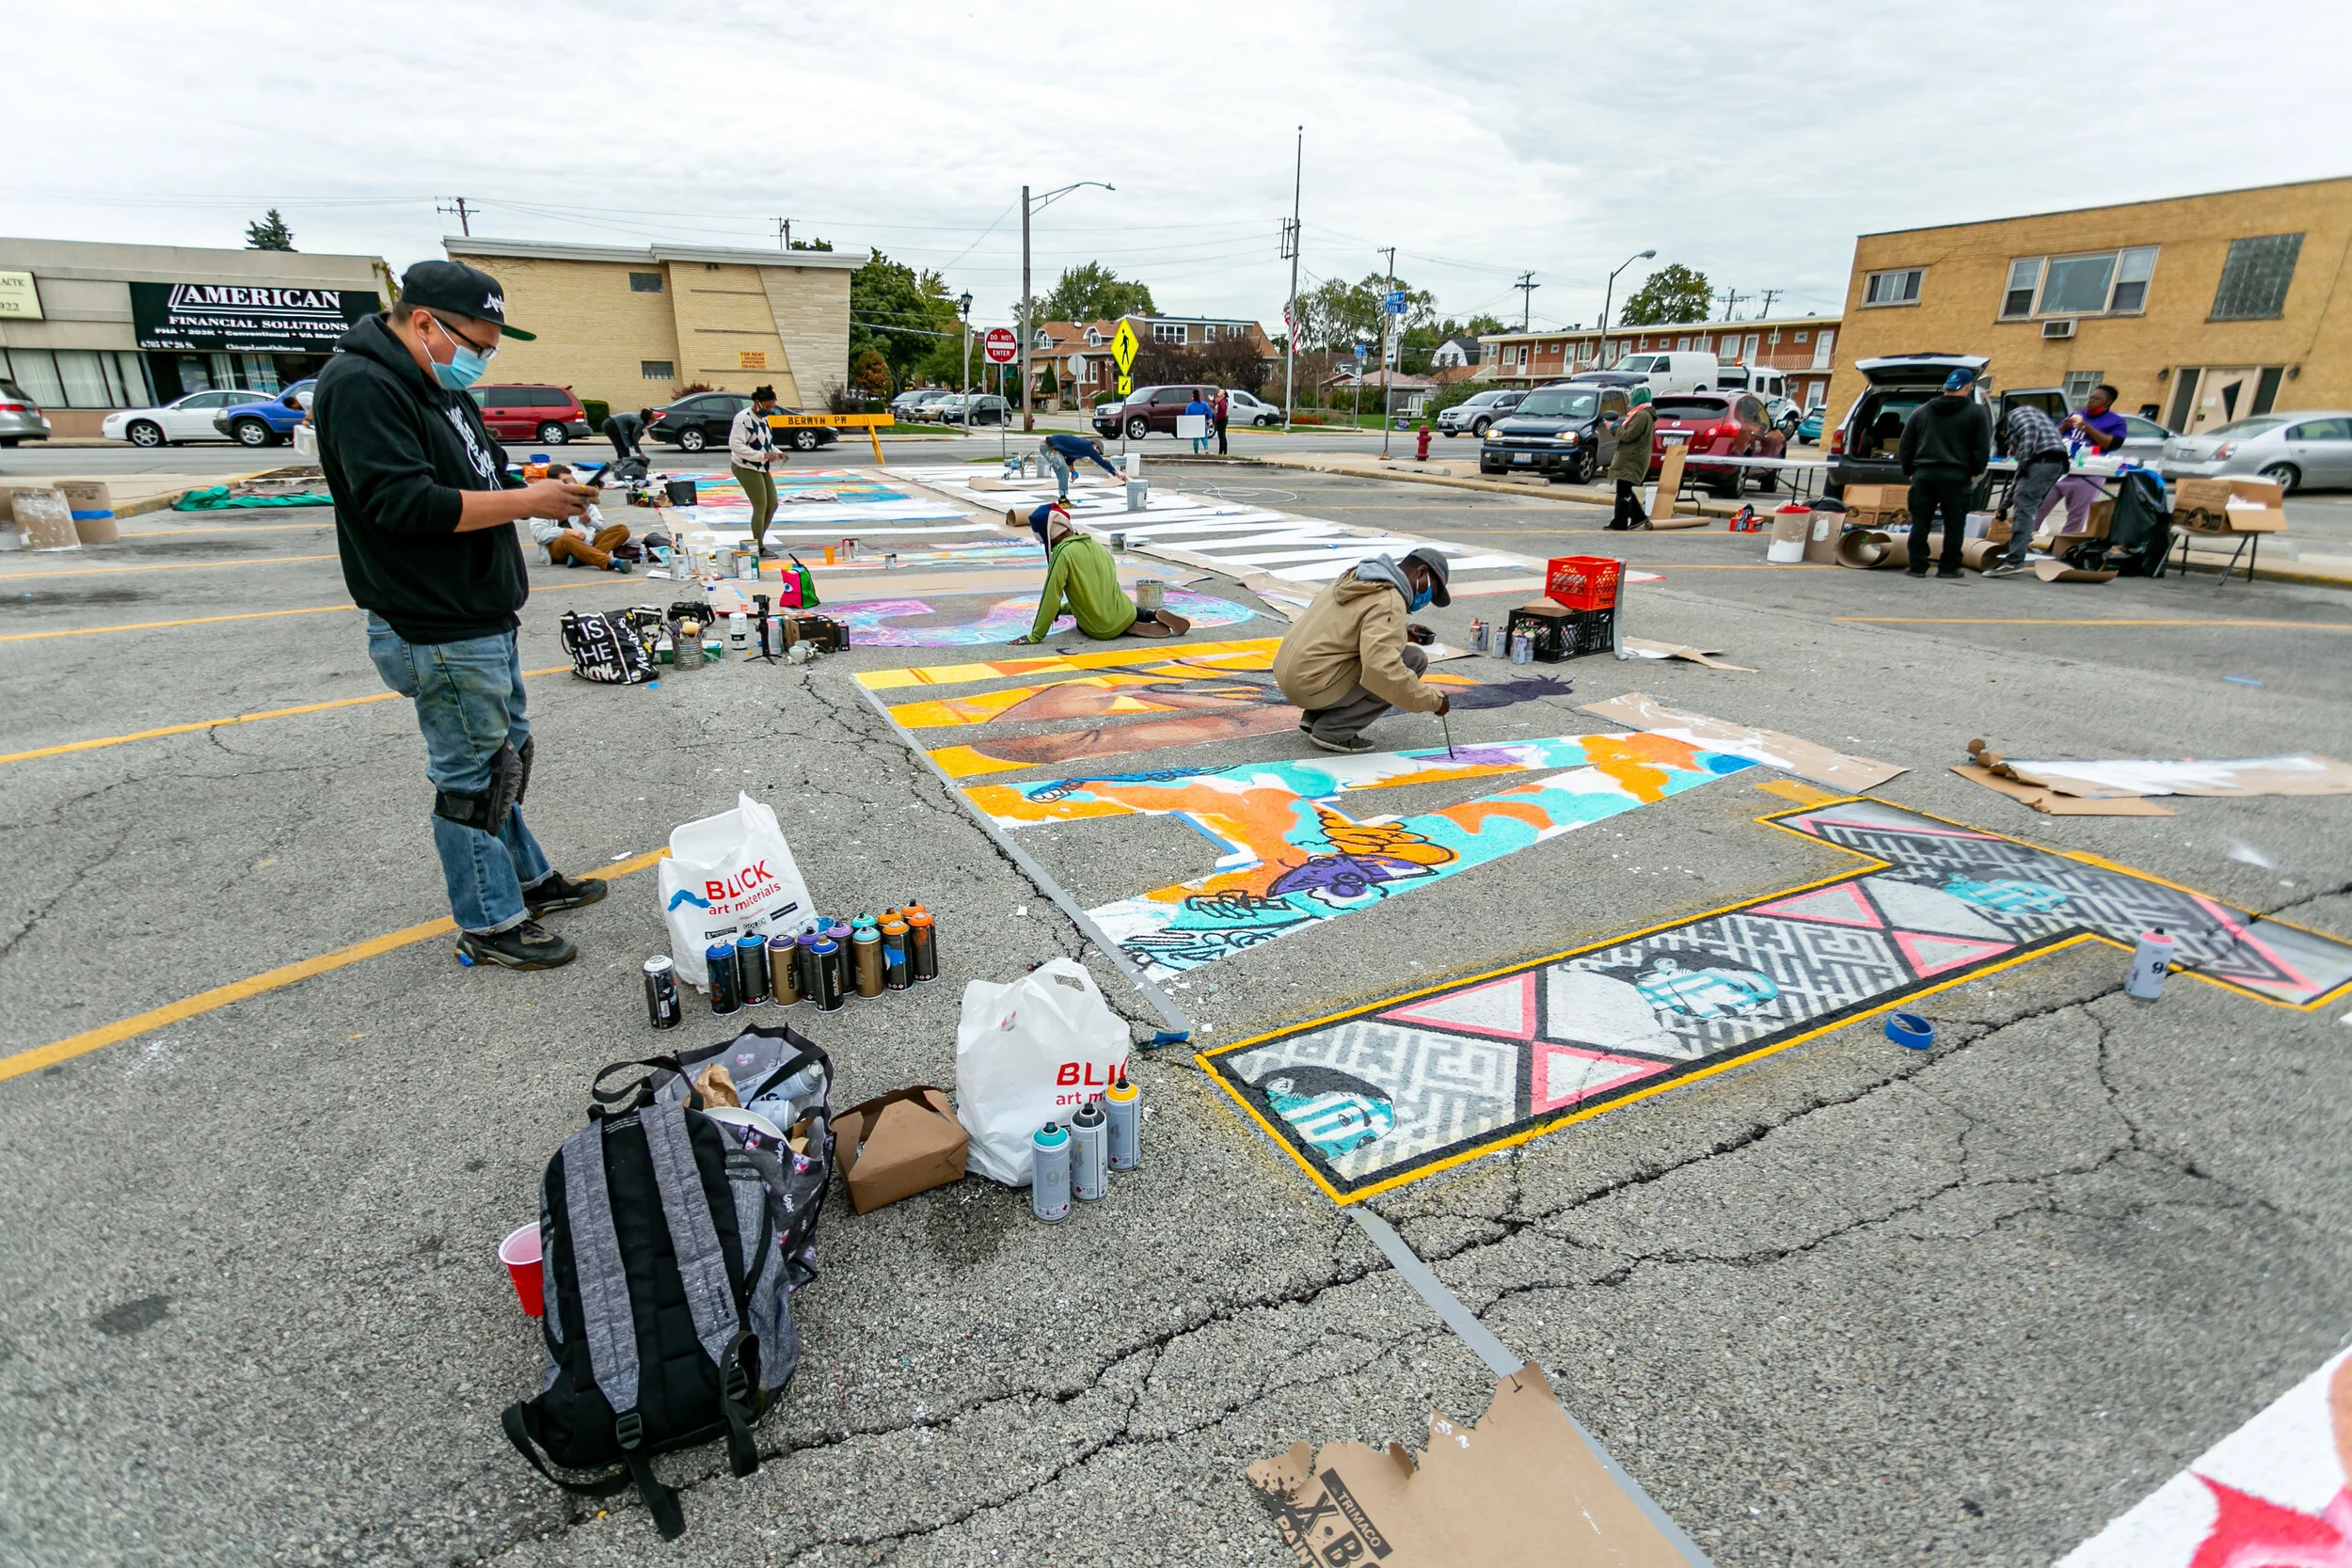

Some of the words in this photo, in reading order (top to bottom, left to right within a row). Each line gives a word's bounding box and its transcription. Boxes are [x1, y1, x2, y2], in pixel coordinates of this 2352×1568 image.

[183, 285, 342, 309] AMERICAN
[169, 316, 258, 328] FINANCIAL
[262, 320, 349, 331] SOLUTIONS
[788, 416, 826, 426] BERWYN
[834, 416, 847, 424] PW
[706, 860, 774, 900] BLICK
[708, 904, 730, 915] art
[735, 882, 781, 912] materials
[1056, 1091, 1082, 1105] art
[1337, 1491, 1381, 1547] TRIMACO
